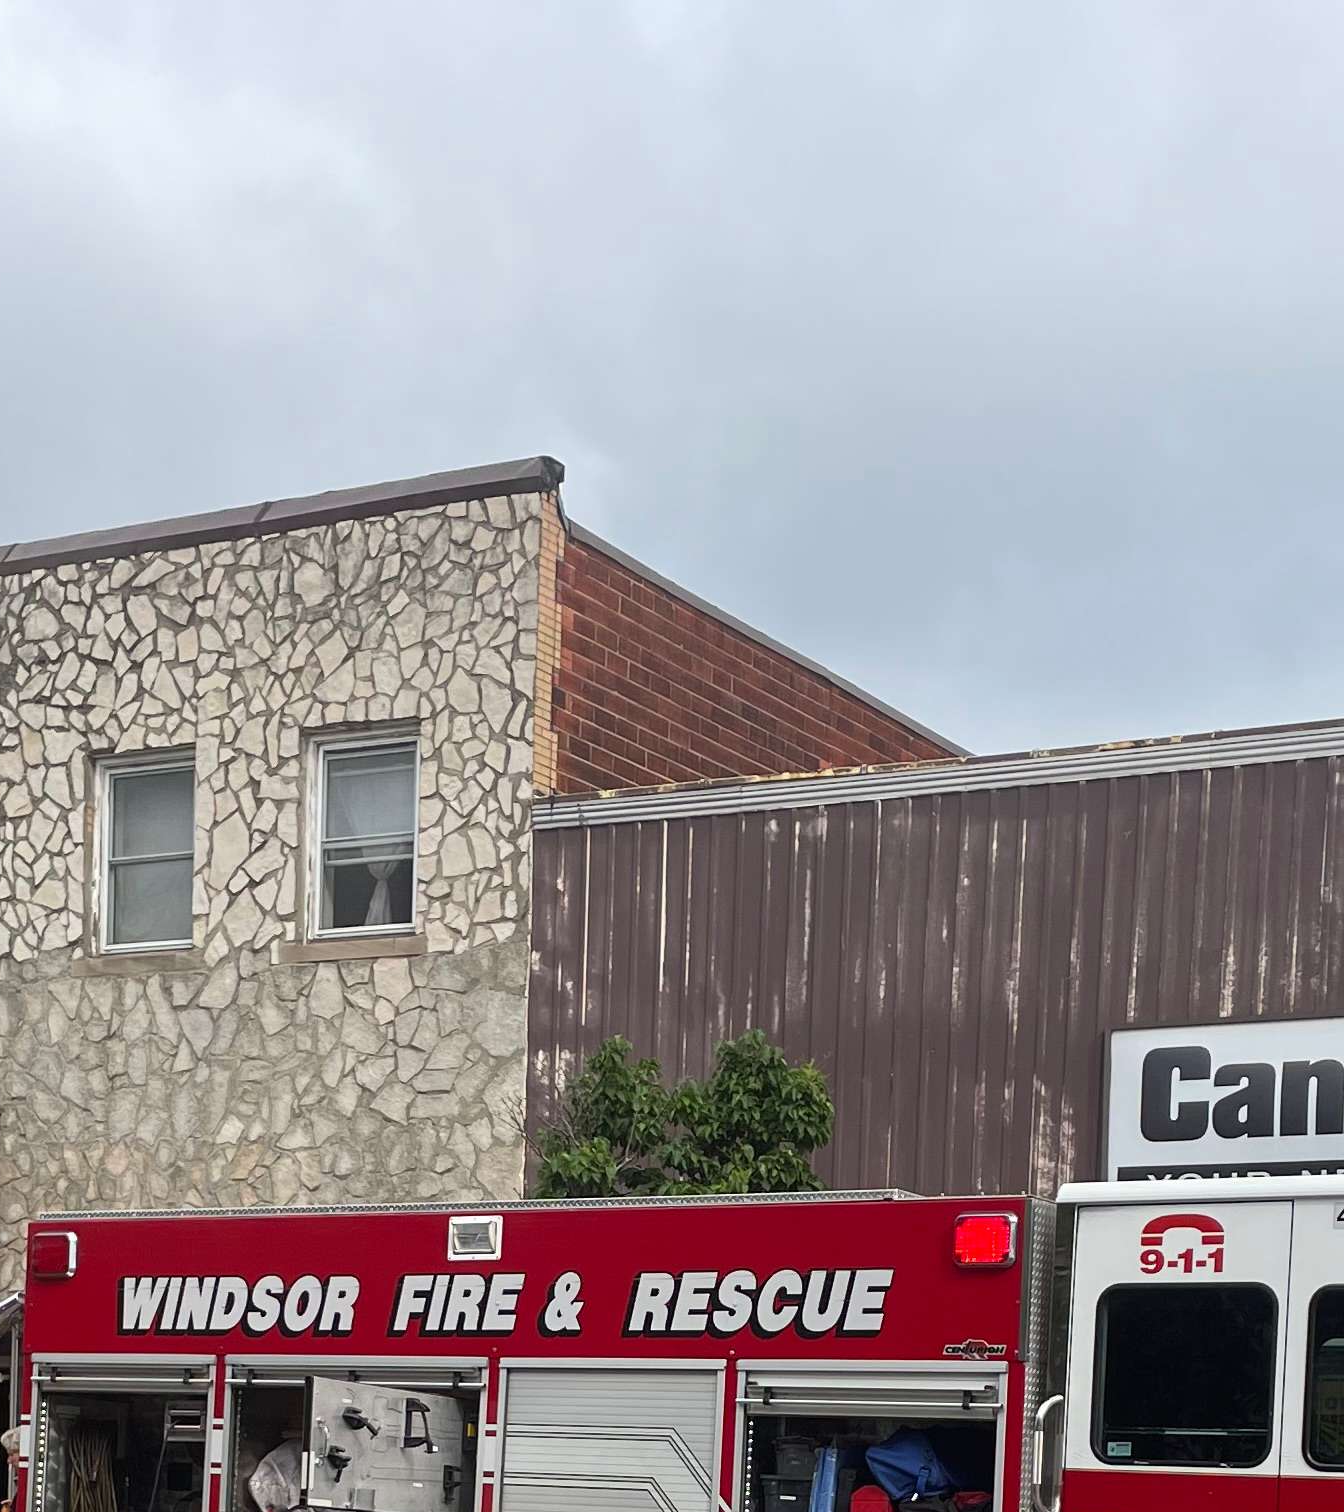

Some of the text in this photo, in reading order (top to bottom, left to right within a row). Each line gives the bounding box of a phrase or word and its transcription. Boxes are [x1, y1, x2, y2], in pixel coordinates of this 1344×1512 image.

[1139, 1247, 1225, 1275] 9-1-1
[119, 1268, 895, 1335] WINDSOR FIRE & RESCUE
